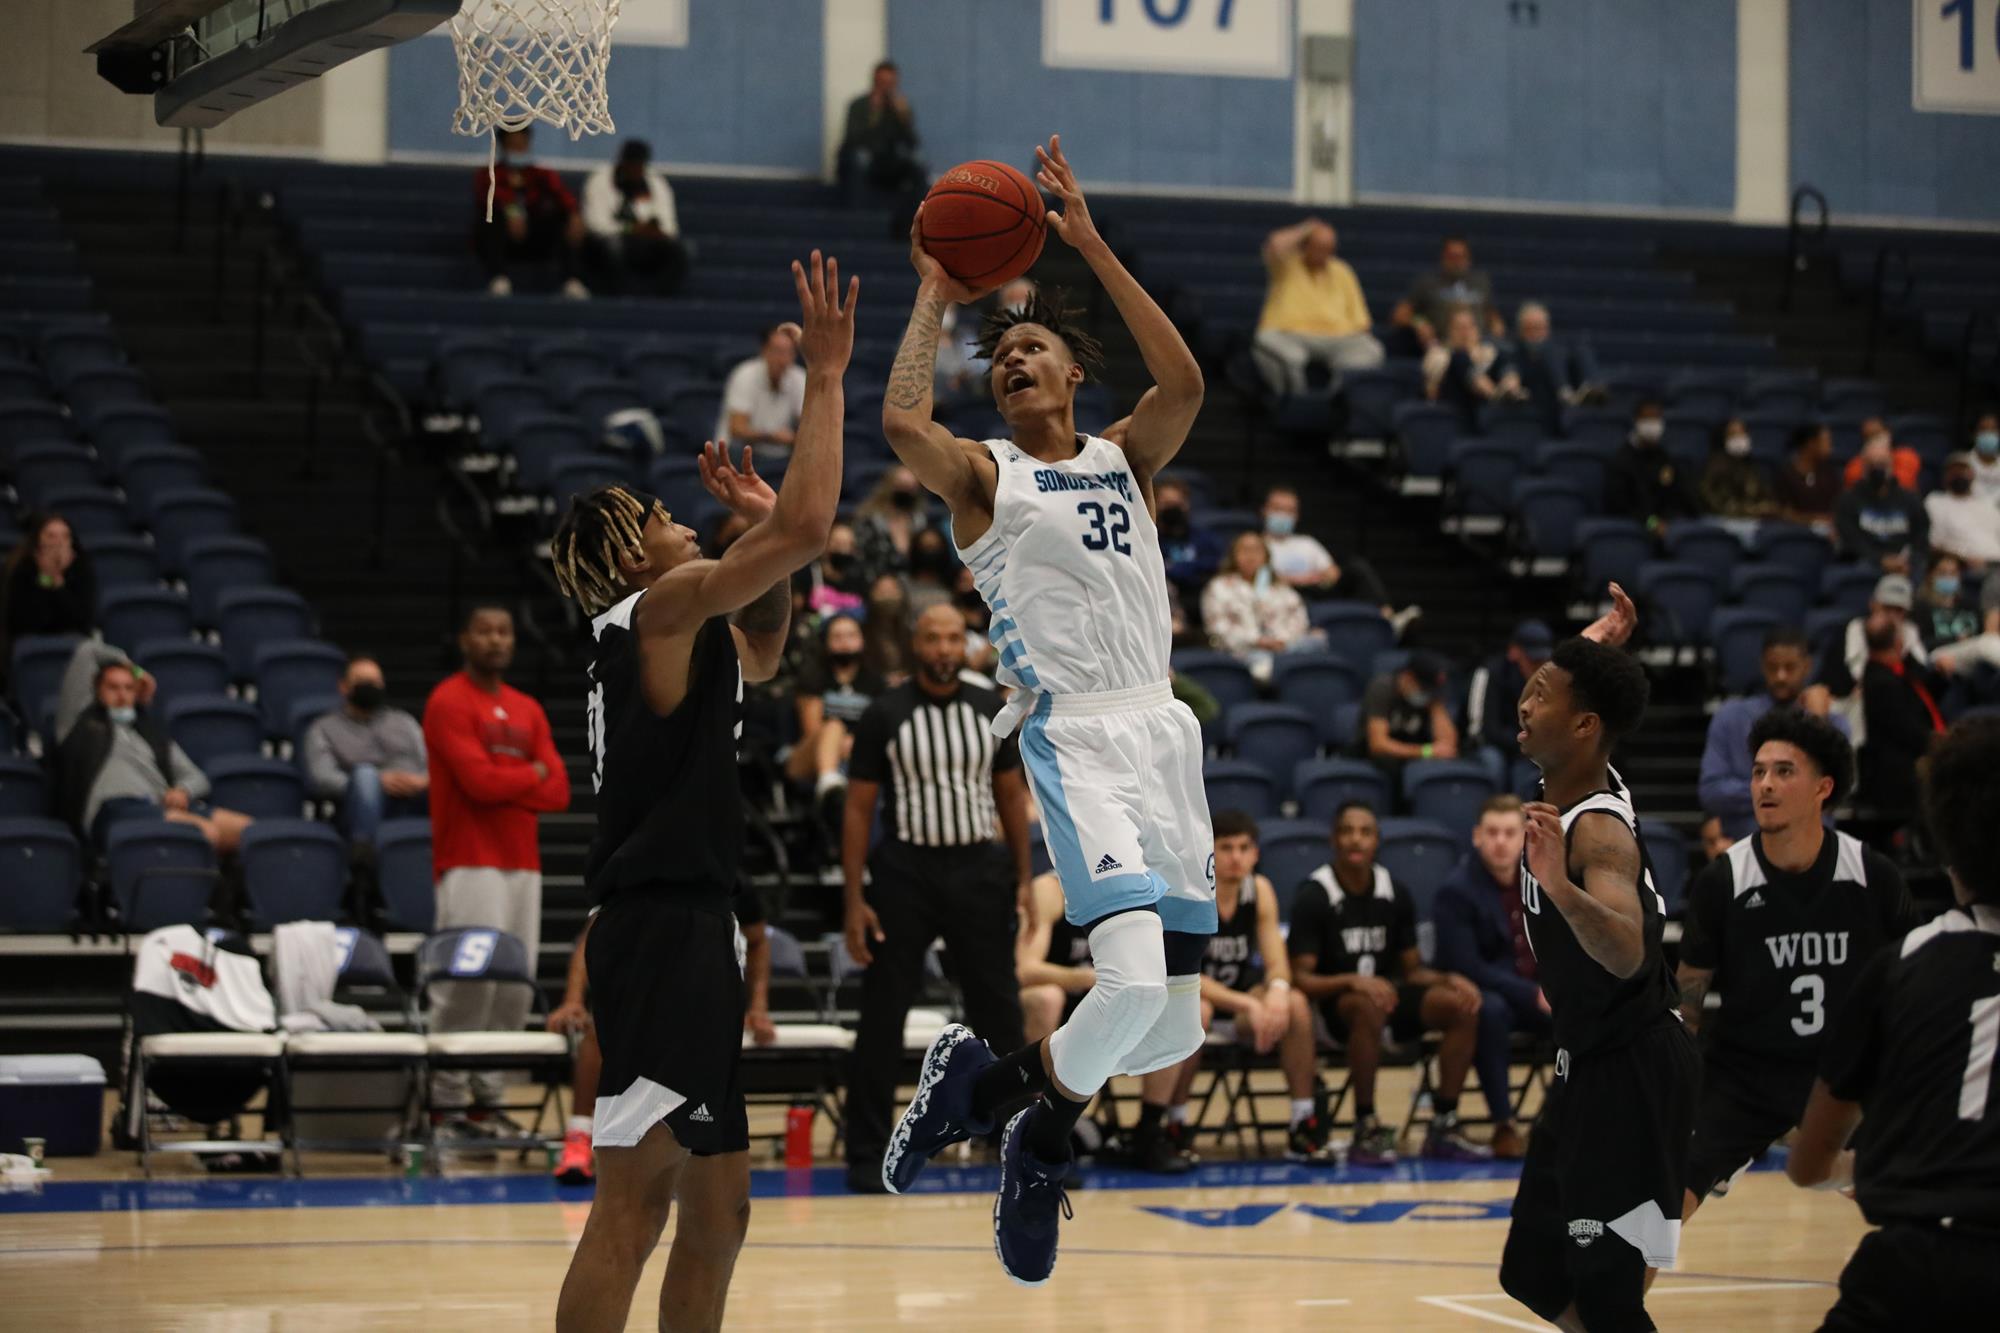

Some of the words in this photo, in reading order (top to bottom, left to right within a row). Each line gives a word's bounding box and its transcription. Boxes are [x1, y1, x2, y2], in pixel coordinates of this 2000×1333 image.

[1077, 501, 1132, 556] 32
[1095, 861, 1123, 874] adidas
[1764, 931, 1849, 969] WOU
[1790, 973, 1825, 1036] 3
